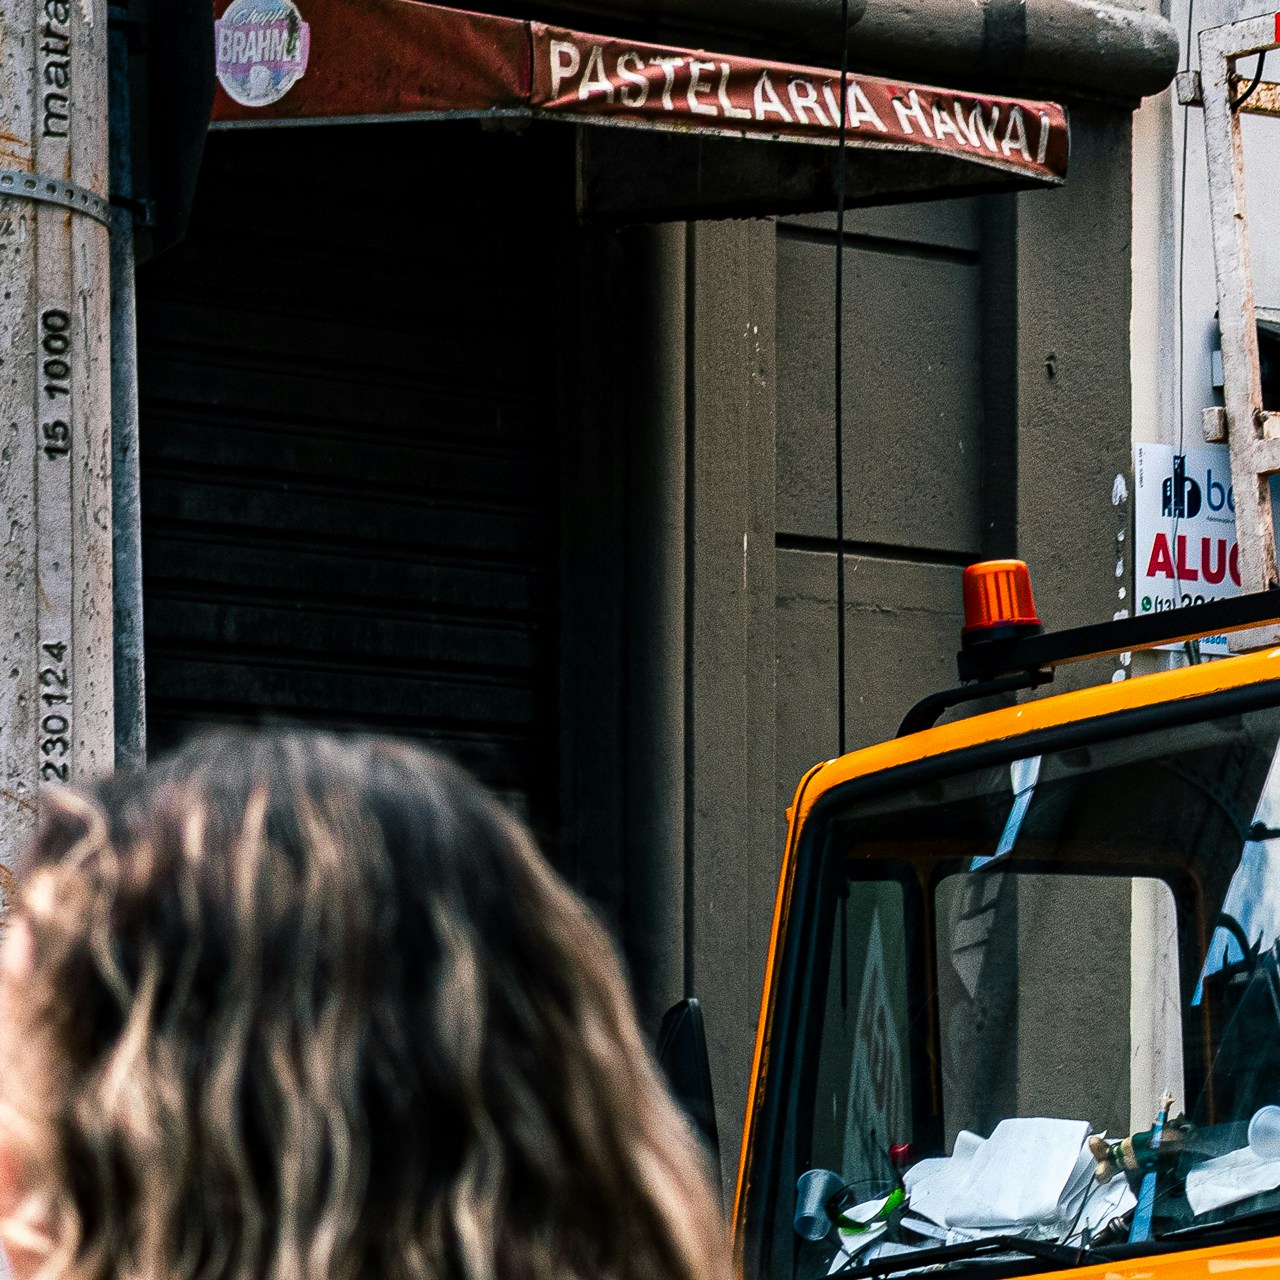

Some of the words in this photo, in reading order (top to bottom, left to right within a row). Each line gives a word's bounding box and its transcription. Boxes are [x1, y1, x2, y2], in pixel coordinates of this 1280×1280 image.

[550, 38, 889, 134] PASTELARIA
[41, 308, 71, 400] 1000
[42, 420, 70, 461] 15
[39, 640, 70, 783] 230124
